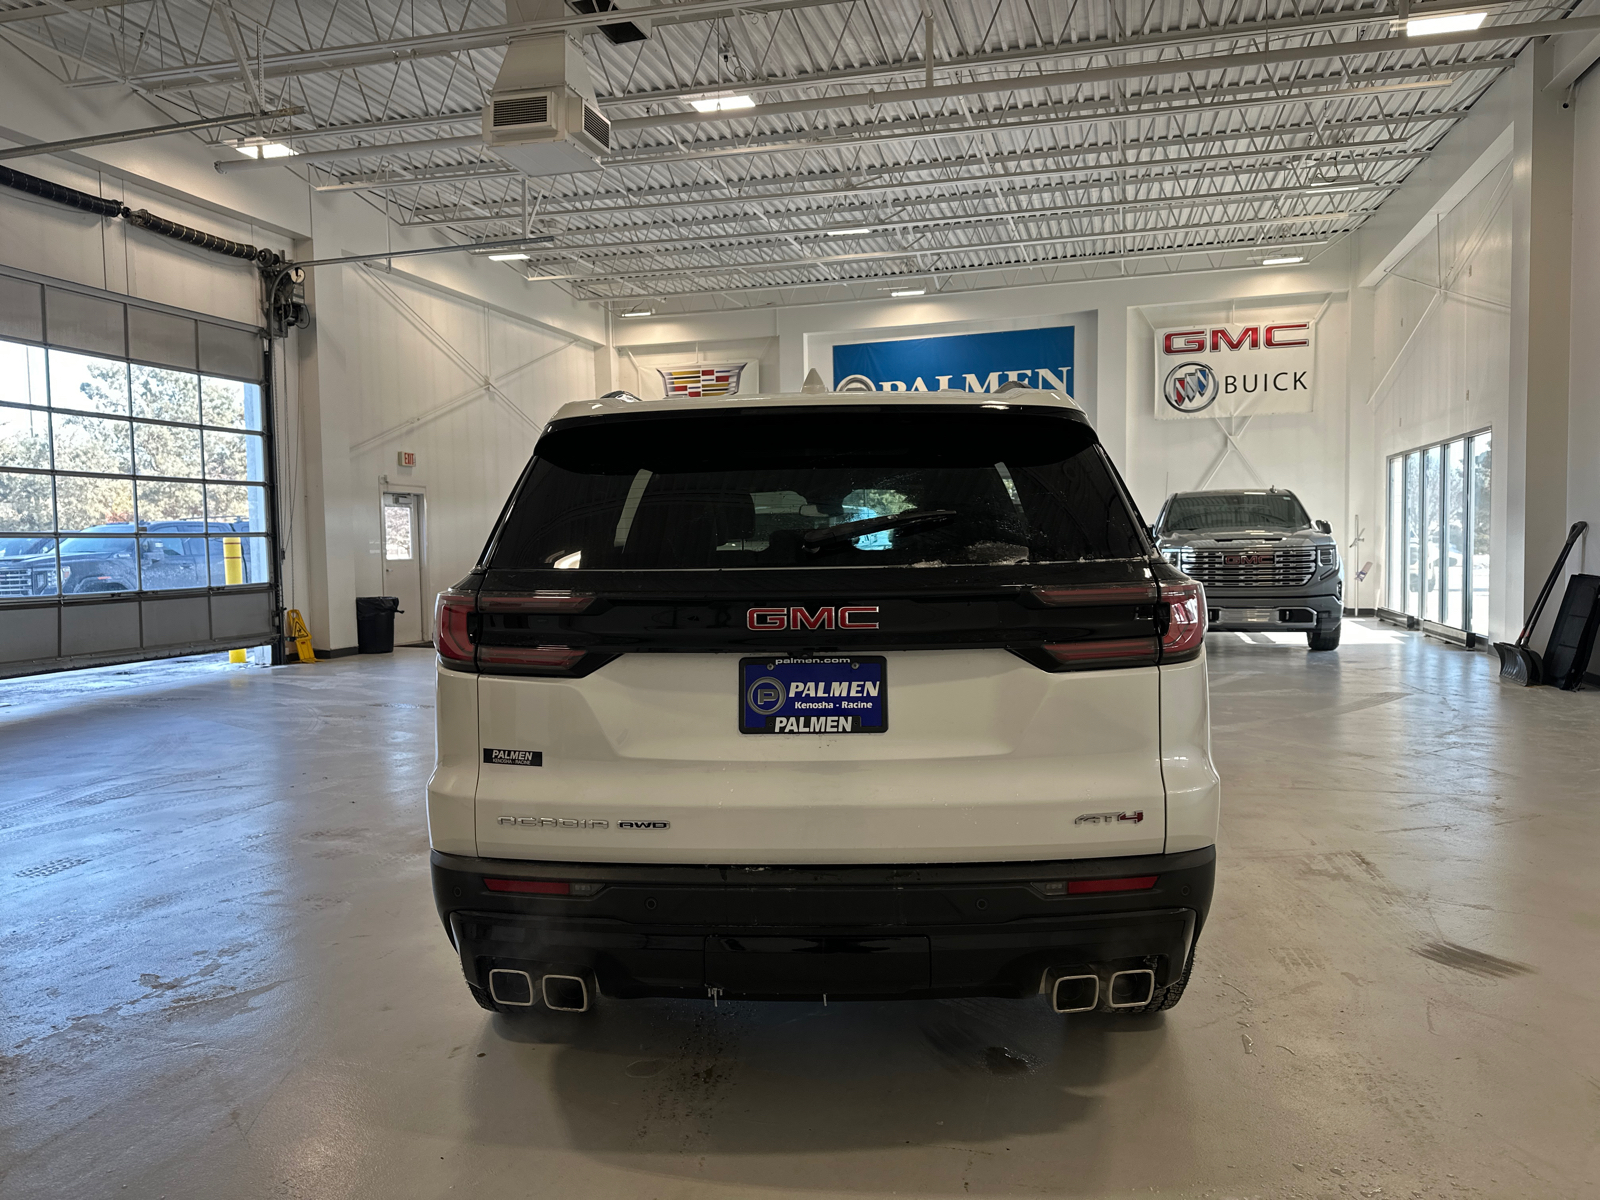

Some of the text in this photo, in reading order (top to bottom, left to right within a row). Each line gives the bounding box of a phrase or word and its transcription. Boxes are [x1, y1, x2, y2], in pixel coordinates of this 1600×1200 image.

[1163, 322, 1309, 355] GMC
[1225, 371, 1307, 394] BUICK
[404, 452, 414, 465] EXIT
[1225, 555, 1274, 565] GMC
[746, 605, 880, 631] GMC
[775, 657, 850, 665] palmen.com
[788, 681, 880, 697] PALMEN
[794, 701, 834, 709] Kenosha
[841, 701, 873, 709] Racine
[774, 716, 853, 733] PALMEN
[492, 749, 533, 761] PALMEN
[497, 815, 671, 830] ACADIA AWD
[1074, 810, 1144, 825] AT4
